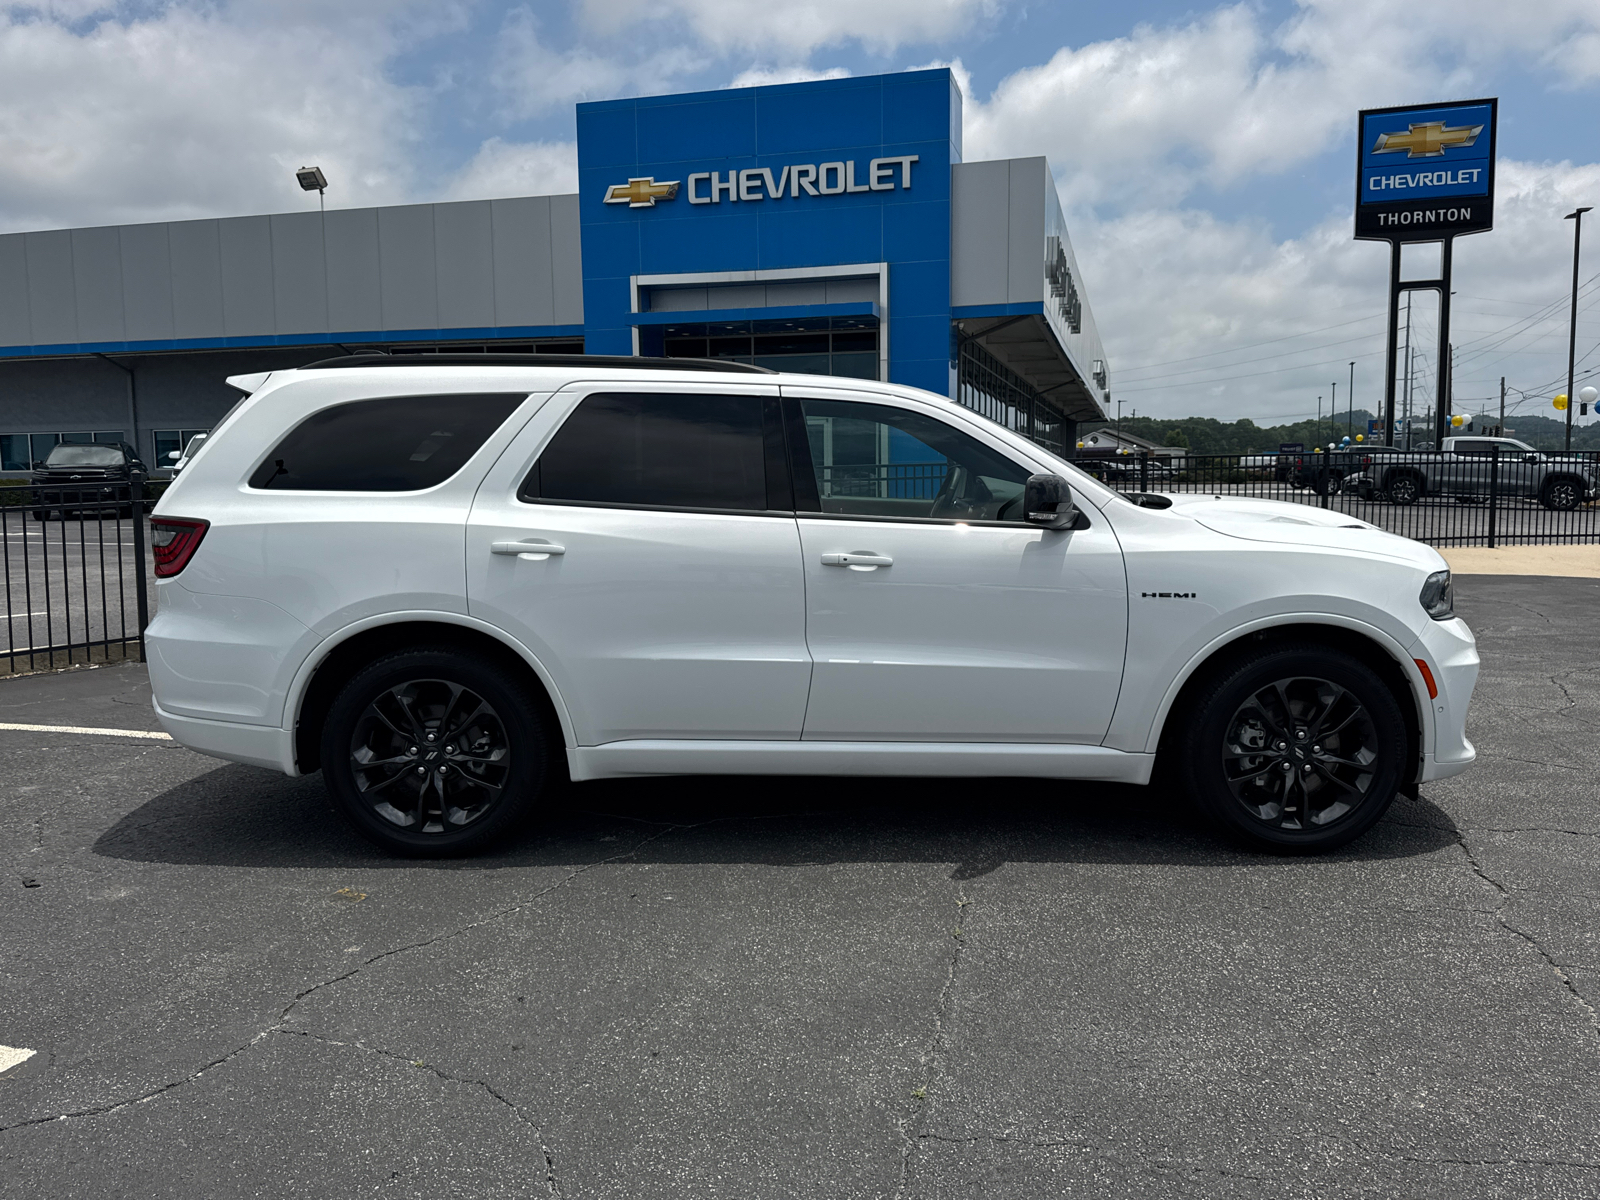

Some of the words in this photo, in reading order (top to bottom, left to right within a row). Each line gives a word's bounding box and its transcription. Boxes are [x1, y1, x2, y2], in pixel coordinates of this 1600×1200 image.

[687, 155, 919, 204] CHEVROLET
[1369, 168, 1482, 191] CHEVROLET
[1377, 207, 1471, 226] THORNTON
